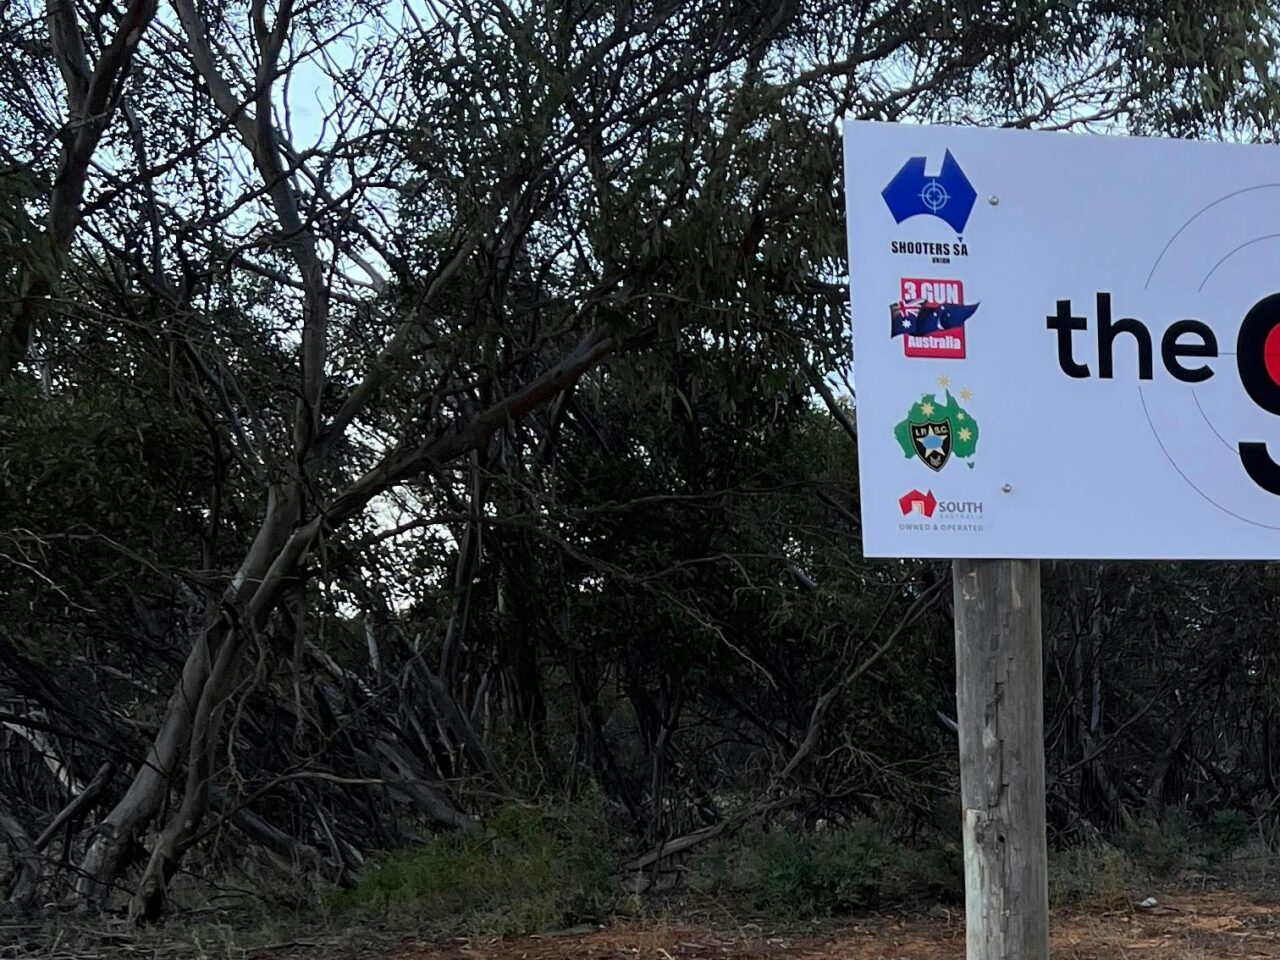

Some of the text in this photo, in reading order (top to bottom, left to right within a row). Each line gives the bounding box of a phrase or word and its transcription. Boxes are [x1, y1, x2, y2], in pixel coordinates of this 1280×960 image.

[891, 241, 968, 256] SHOOTERS SA
[904, 281, 959, 304] 3 GUN
[907, 335, 961, 350] Australia
[938, 501, 983, 513] SOUTH
[899, 523, 931, 531] OWNED
[941, 524, 984, 532] OPERATED
